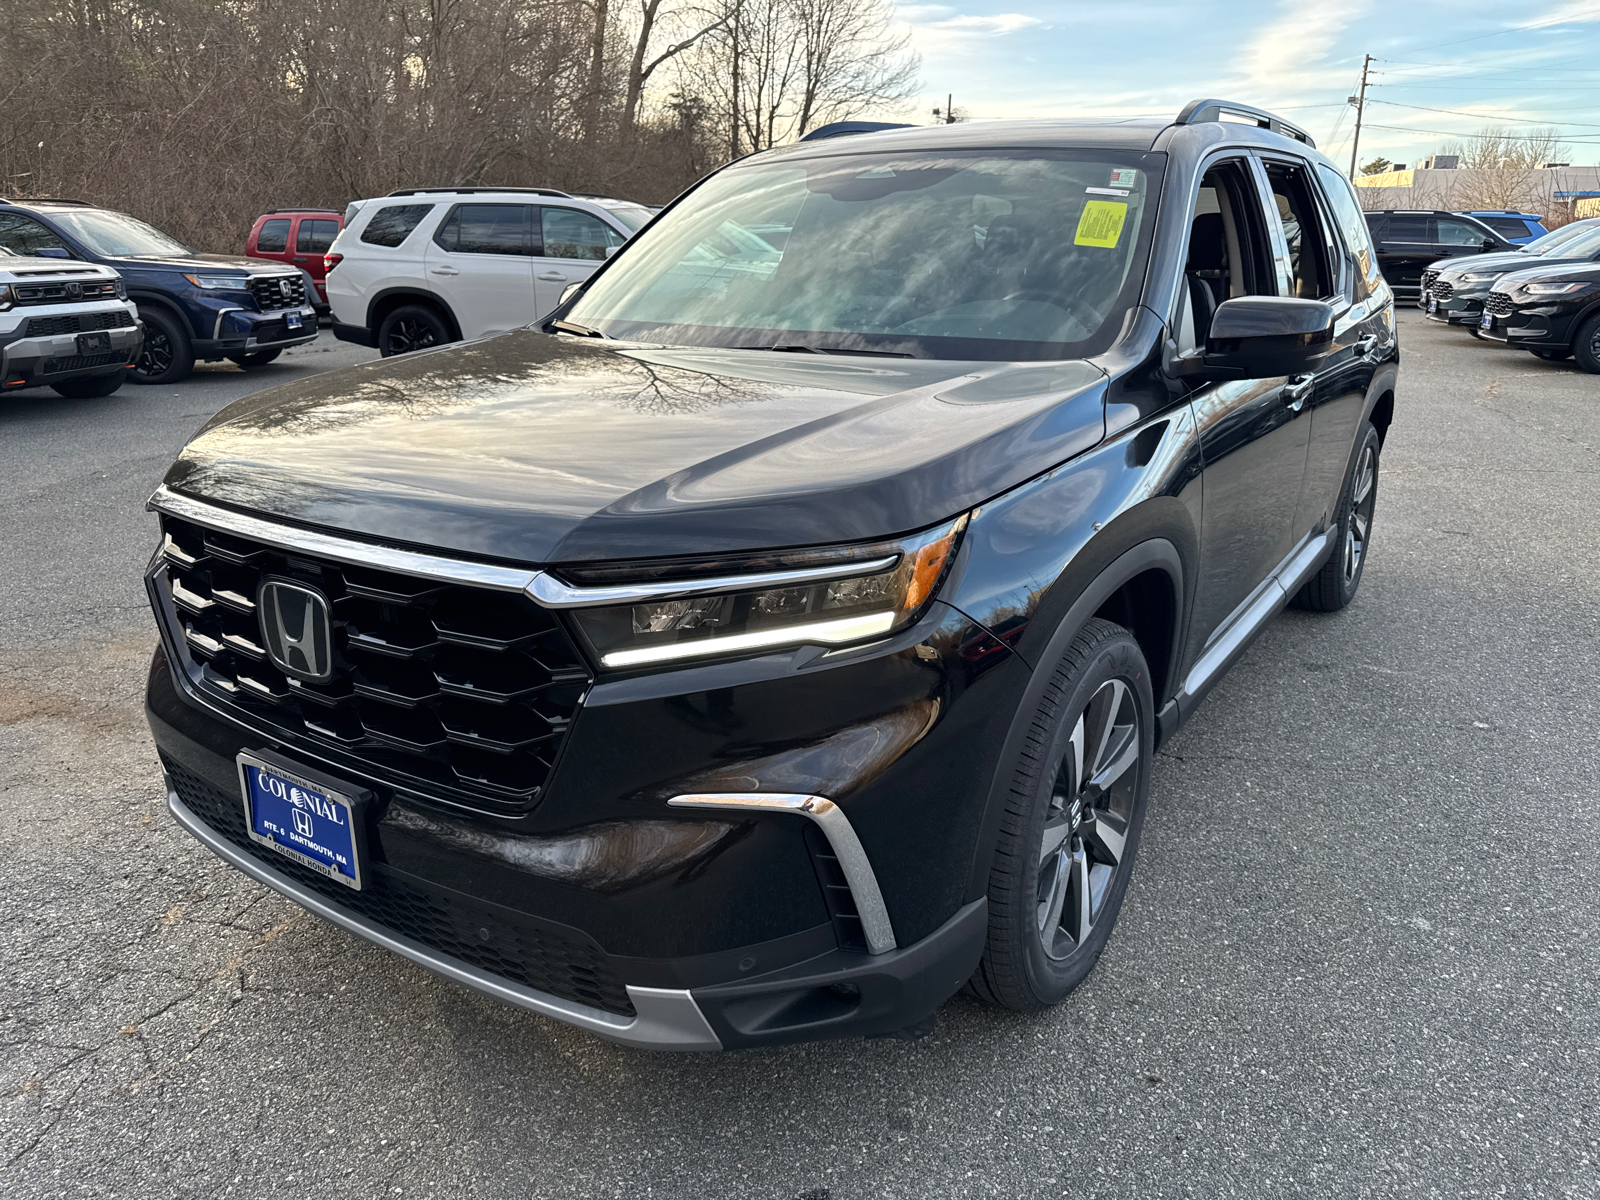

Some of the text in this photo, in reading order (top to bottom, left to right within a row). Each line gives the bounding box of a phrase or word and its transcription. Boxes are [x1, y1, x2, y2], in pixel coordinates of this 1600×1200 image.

[258, 773, 344, 826] COLONIAL
[263, 820, 347, 866] RTE. 6 DARTMOUTH, MA
[274, 843, 332, 877] COLONIAL HONDA
